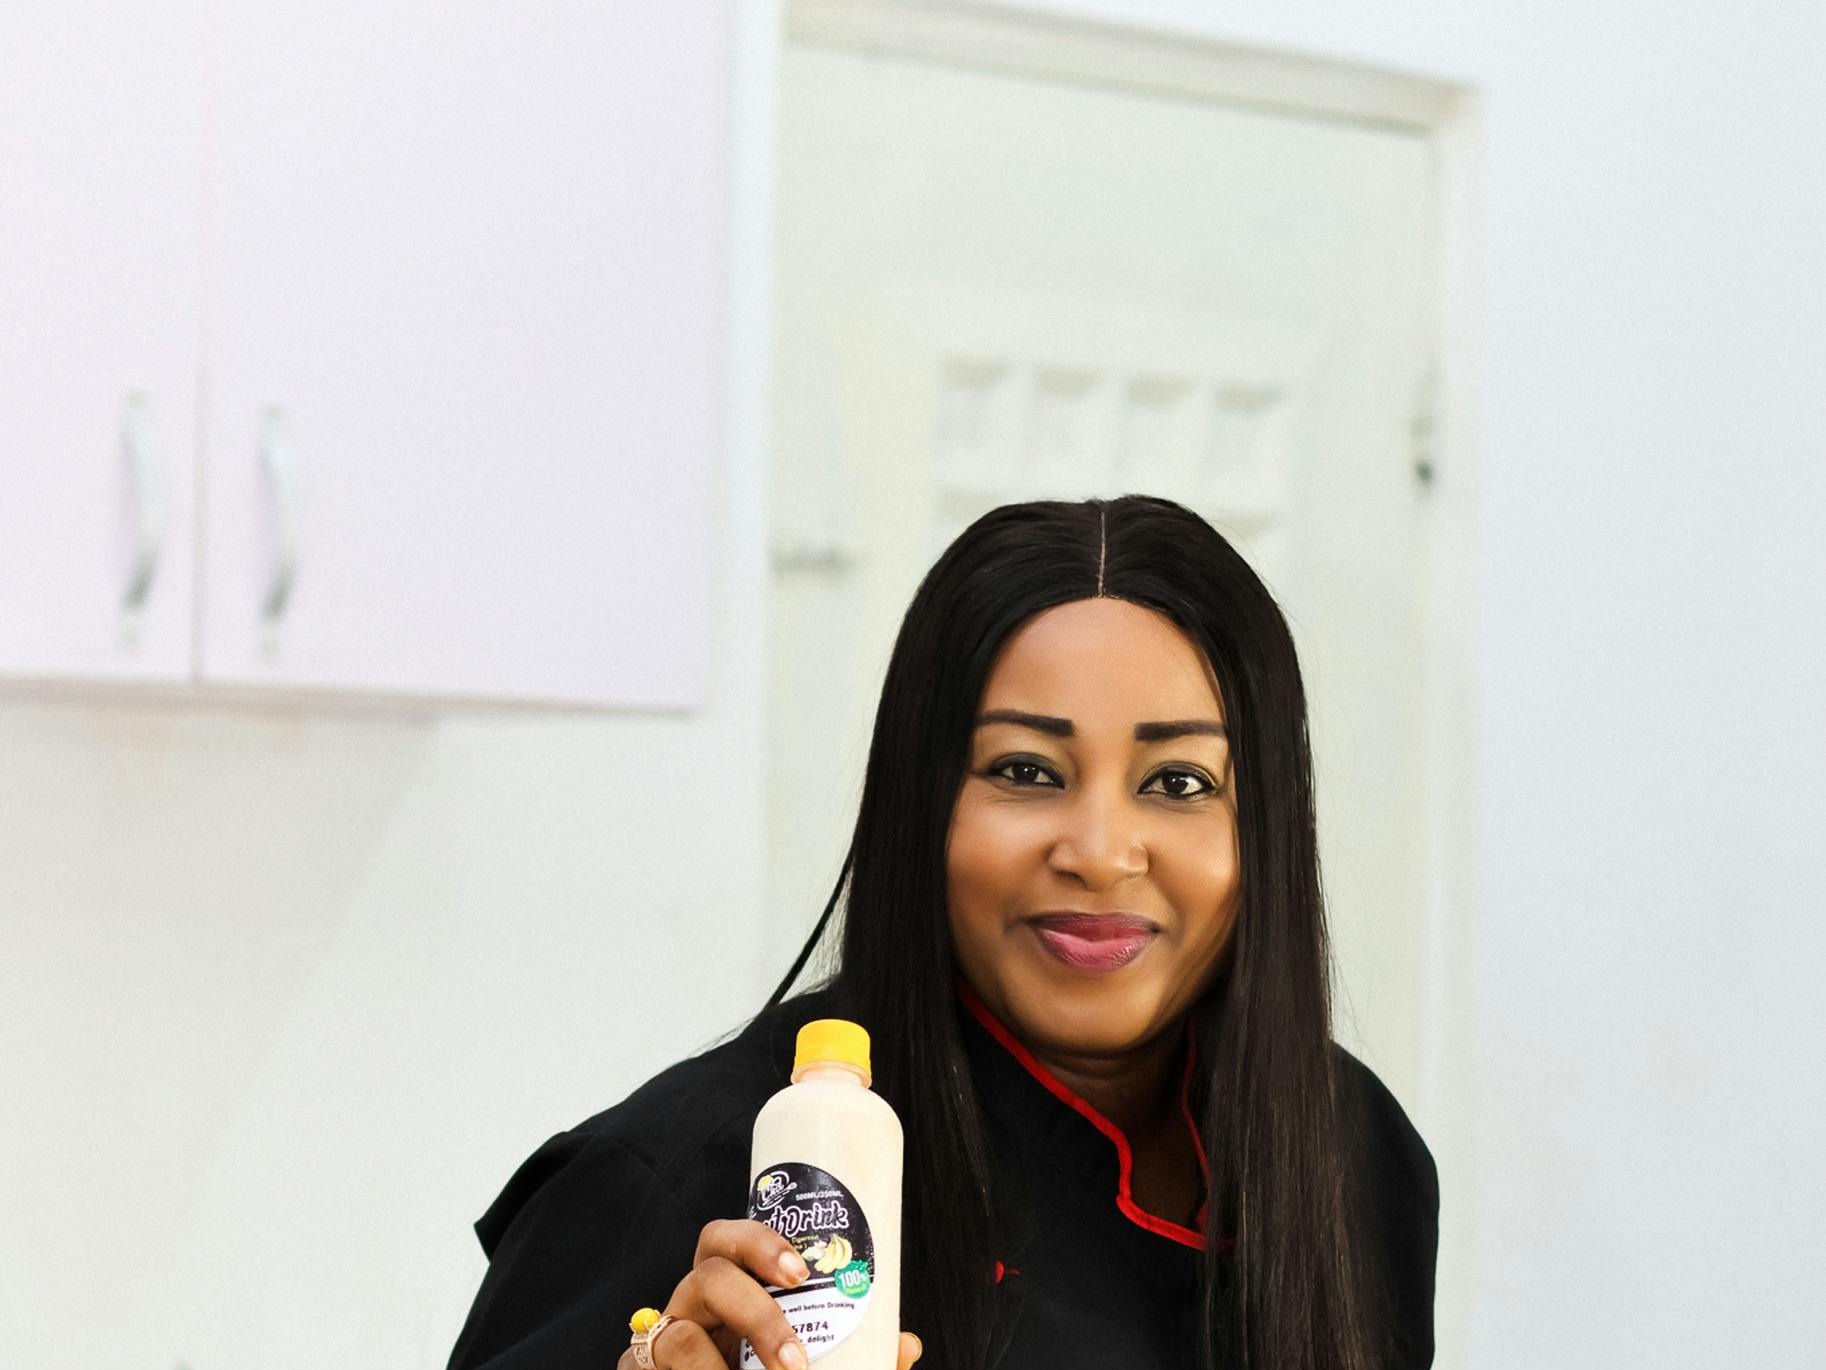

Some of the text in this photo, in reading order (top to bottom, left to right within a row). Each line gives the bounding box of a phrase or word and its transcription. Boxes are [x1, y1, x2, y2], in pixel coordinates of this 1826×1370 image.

[785, 1200, 849, 1237] Drink
[788, 1300, 855, 1314] well before Drinking
